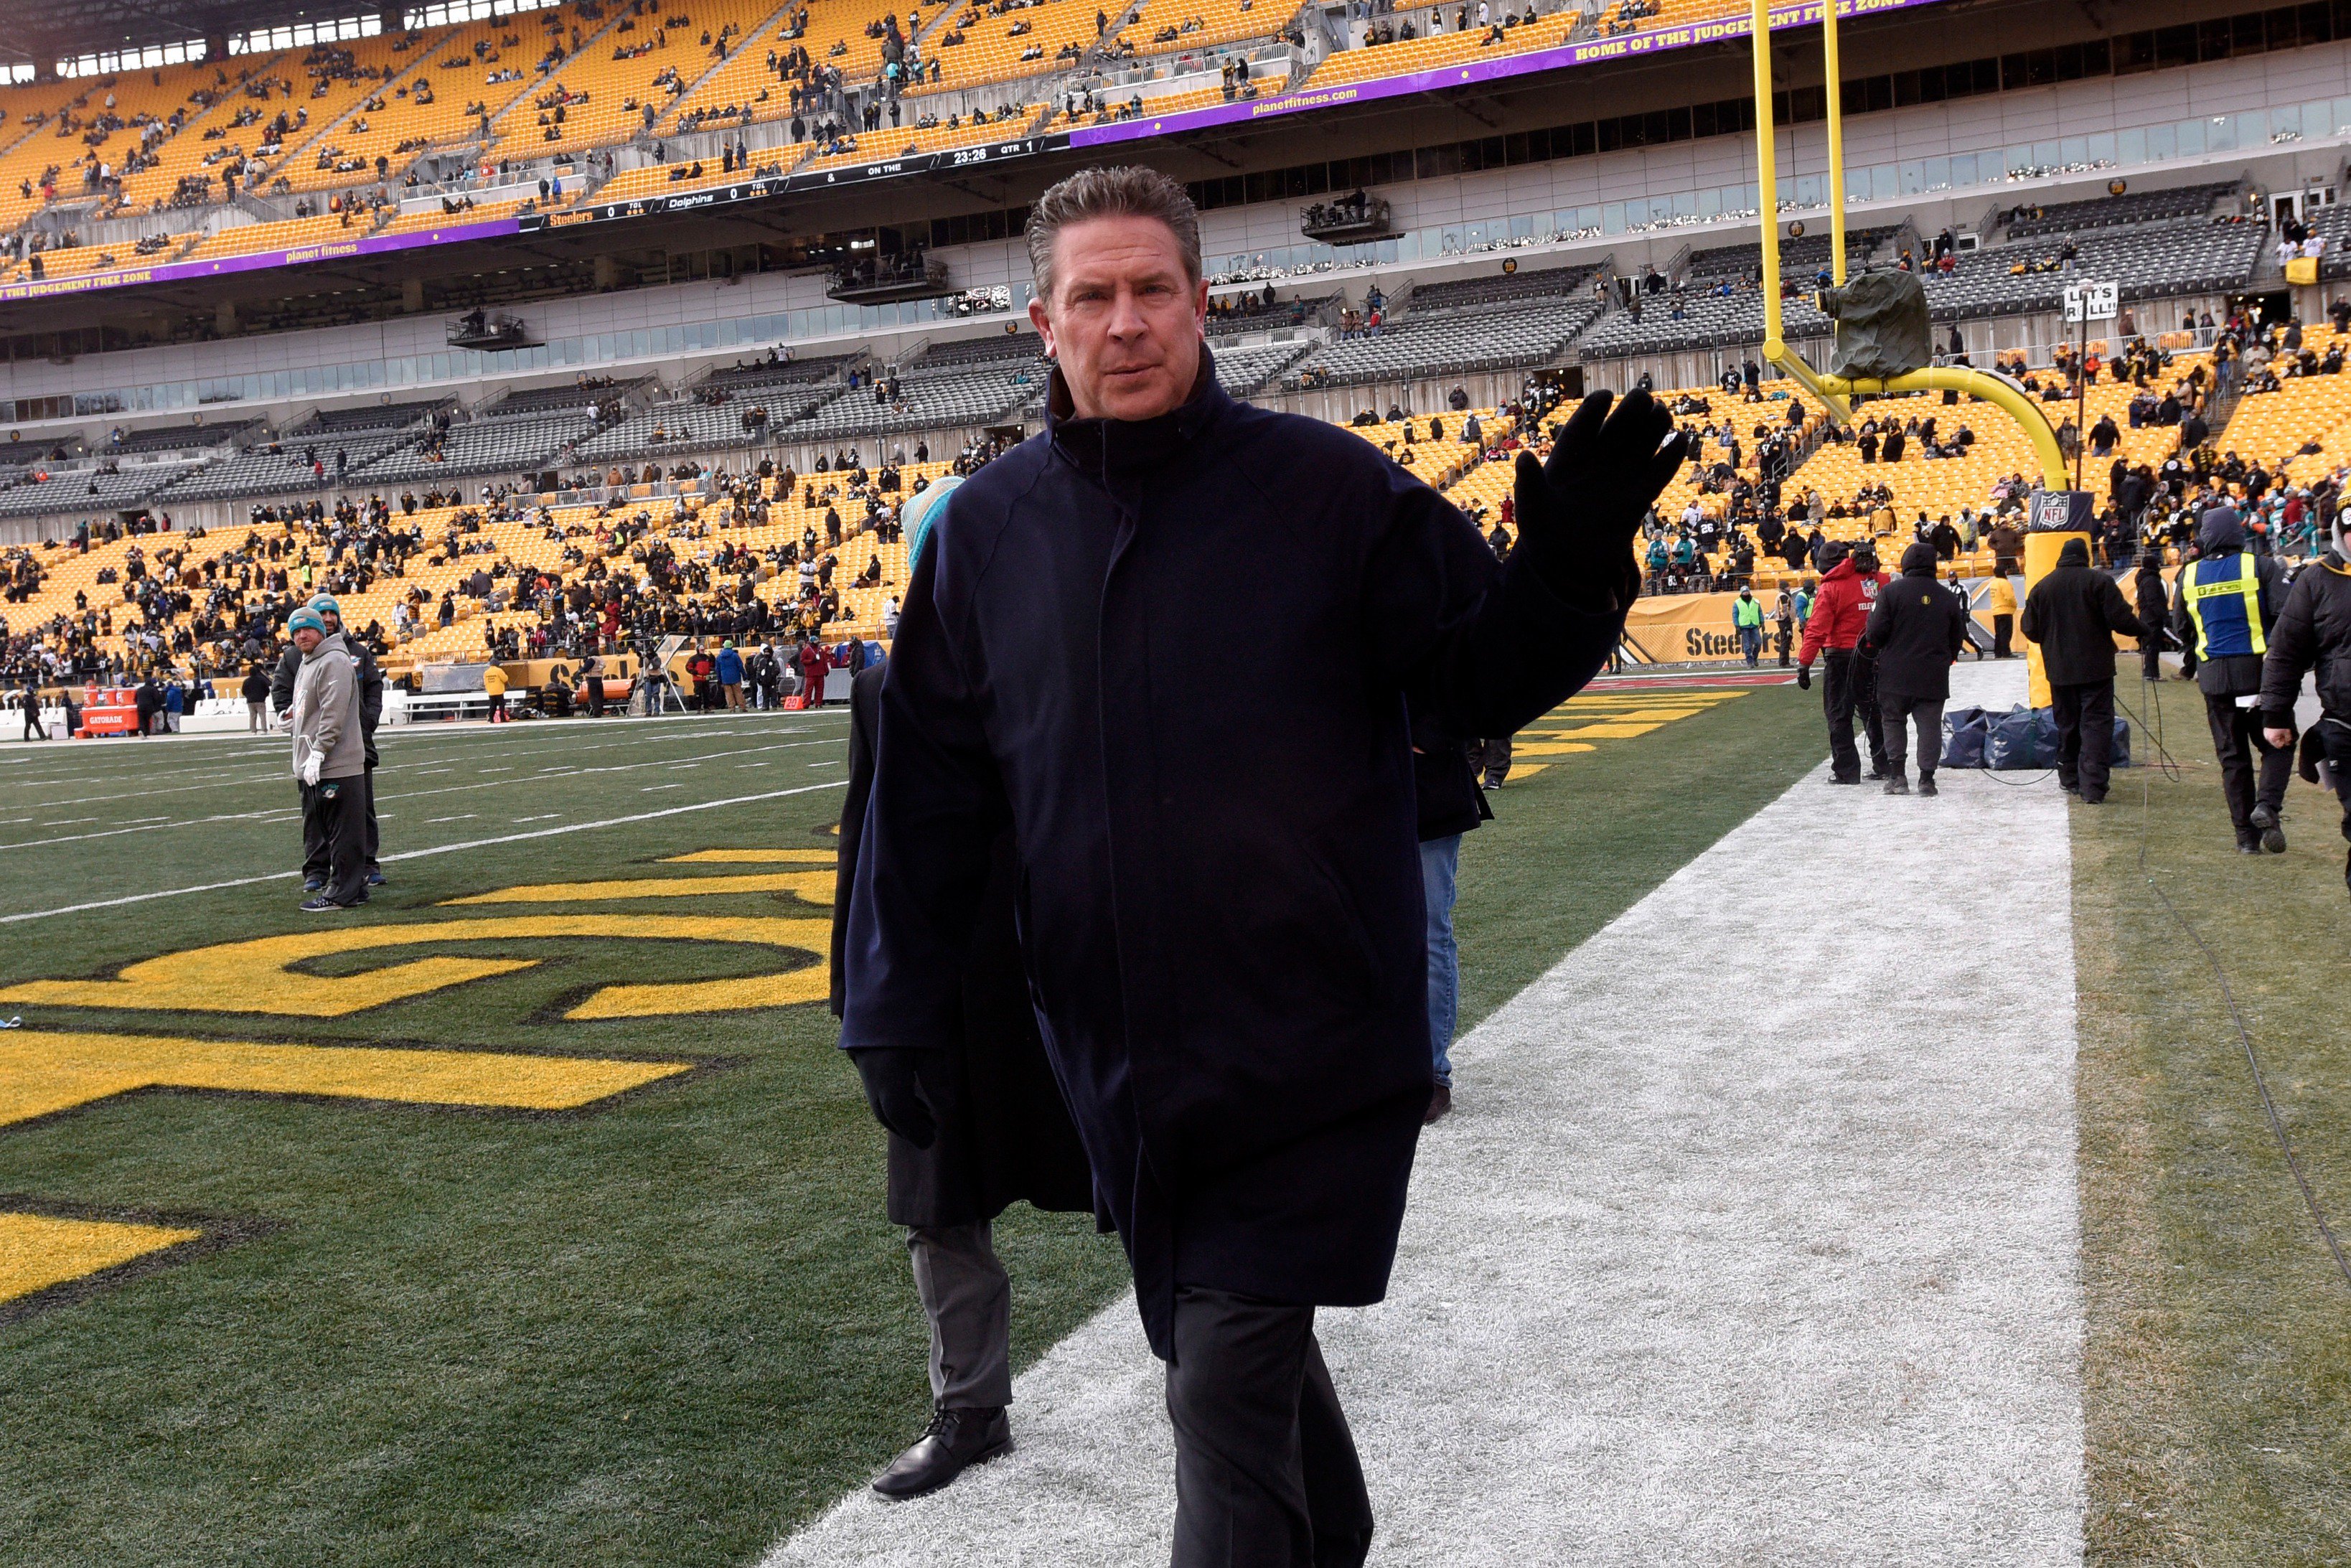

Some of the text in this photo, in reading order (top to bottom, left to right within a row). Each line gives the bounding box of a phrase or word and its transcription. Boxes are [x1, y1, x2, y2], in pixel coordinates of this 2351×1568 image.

[1575, 41, 1626, 60] HOME
[1630, 37, 1653, 50] OF
[1656, 30, 1690, 47] THE
[1694, 9, 1801, 43] JUDGEENT
[1804, 1, 1852, 20] FRE
[1252, 89, 1357, 116] planetfitness.com
[954, 141, 1033, 164] 23:26 QTR 1
[827, 164, 901, 182] & ON THE
[669, 193, 713, 208] Dolphins
[730, 188, 738, 199] 0
[550, 211, 593, 226] Steelers
[607, 207, 615, 217] 0
[286, 244, 357, 263] planet fitness
[6, 287, 27, 297] THE
[29, 278, 91, 297] JUDGEMENT
[94, 275, 121, 286] FREE
[123, 271, 151, 283] ZONE
[2045, 508, 2065, 522] NFL
[1701, 522, 1714, 534] 26
[1686, 627, 1782, 656] Steers
[787, 698, 797, 708] 20
[89, 715, 123, 725] GATORADE
